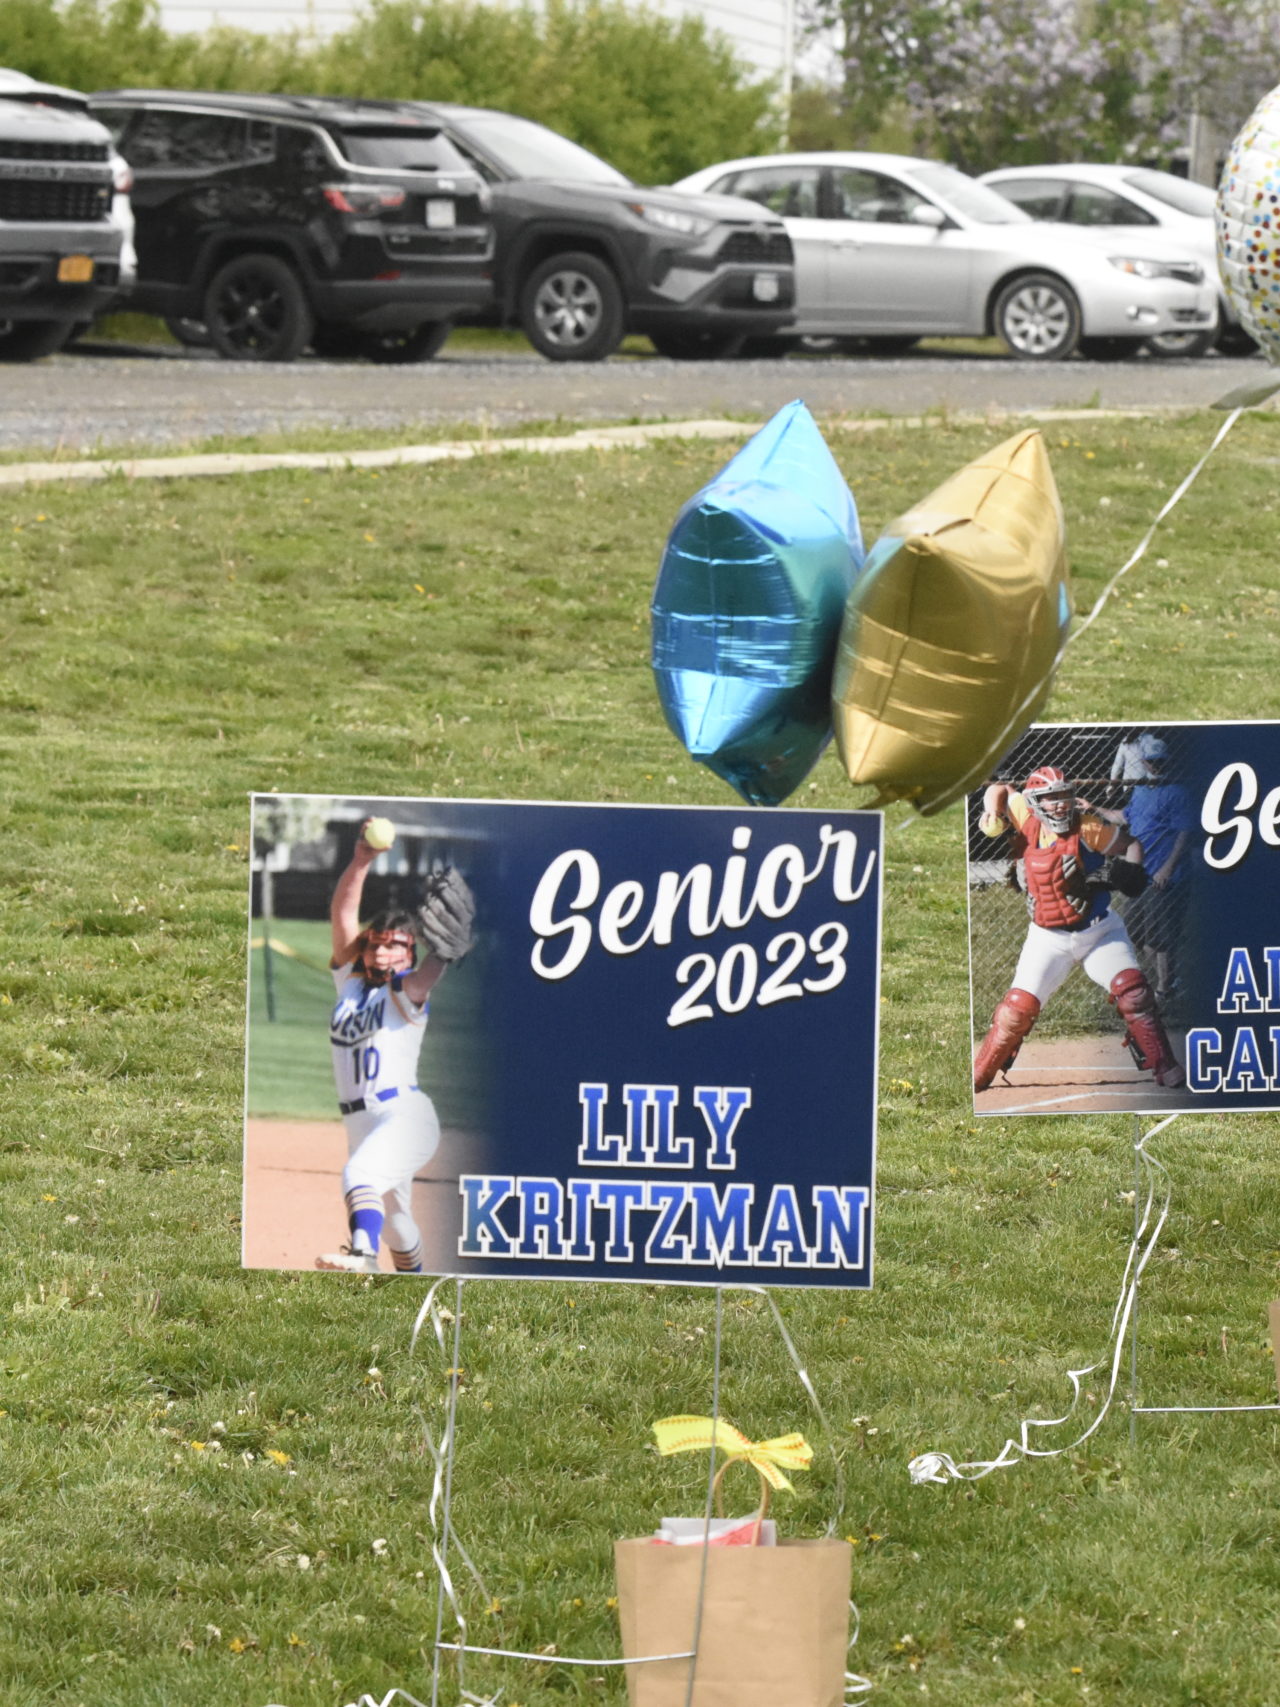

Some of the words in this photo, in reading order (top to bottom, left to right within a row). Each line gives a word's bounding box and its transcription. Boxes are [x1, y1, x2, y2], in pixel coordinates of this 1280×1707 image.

[529, 824, 877, 980] Senior
[666, 921, 850, 1028] 2023
[352, 1046, 380, 1085] 10
[578, 1081, 752, 1170] LILY
[457, 1174, 870, 1271] KRITZMAN
